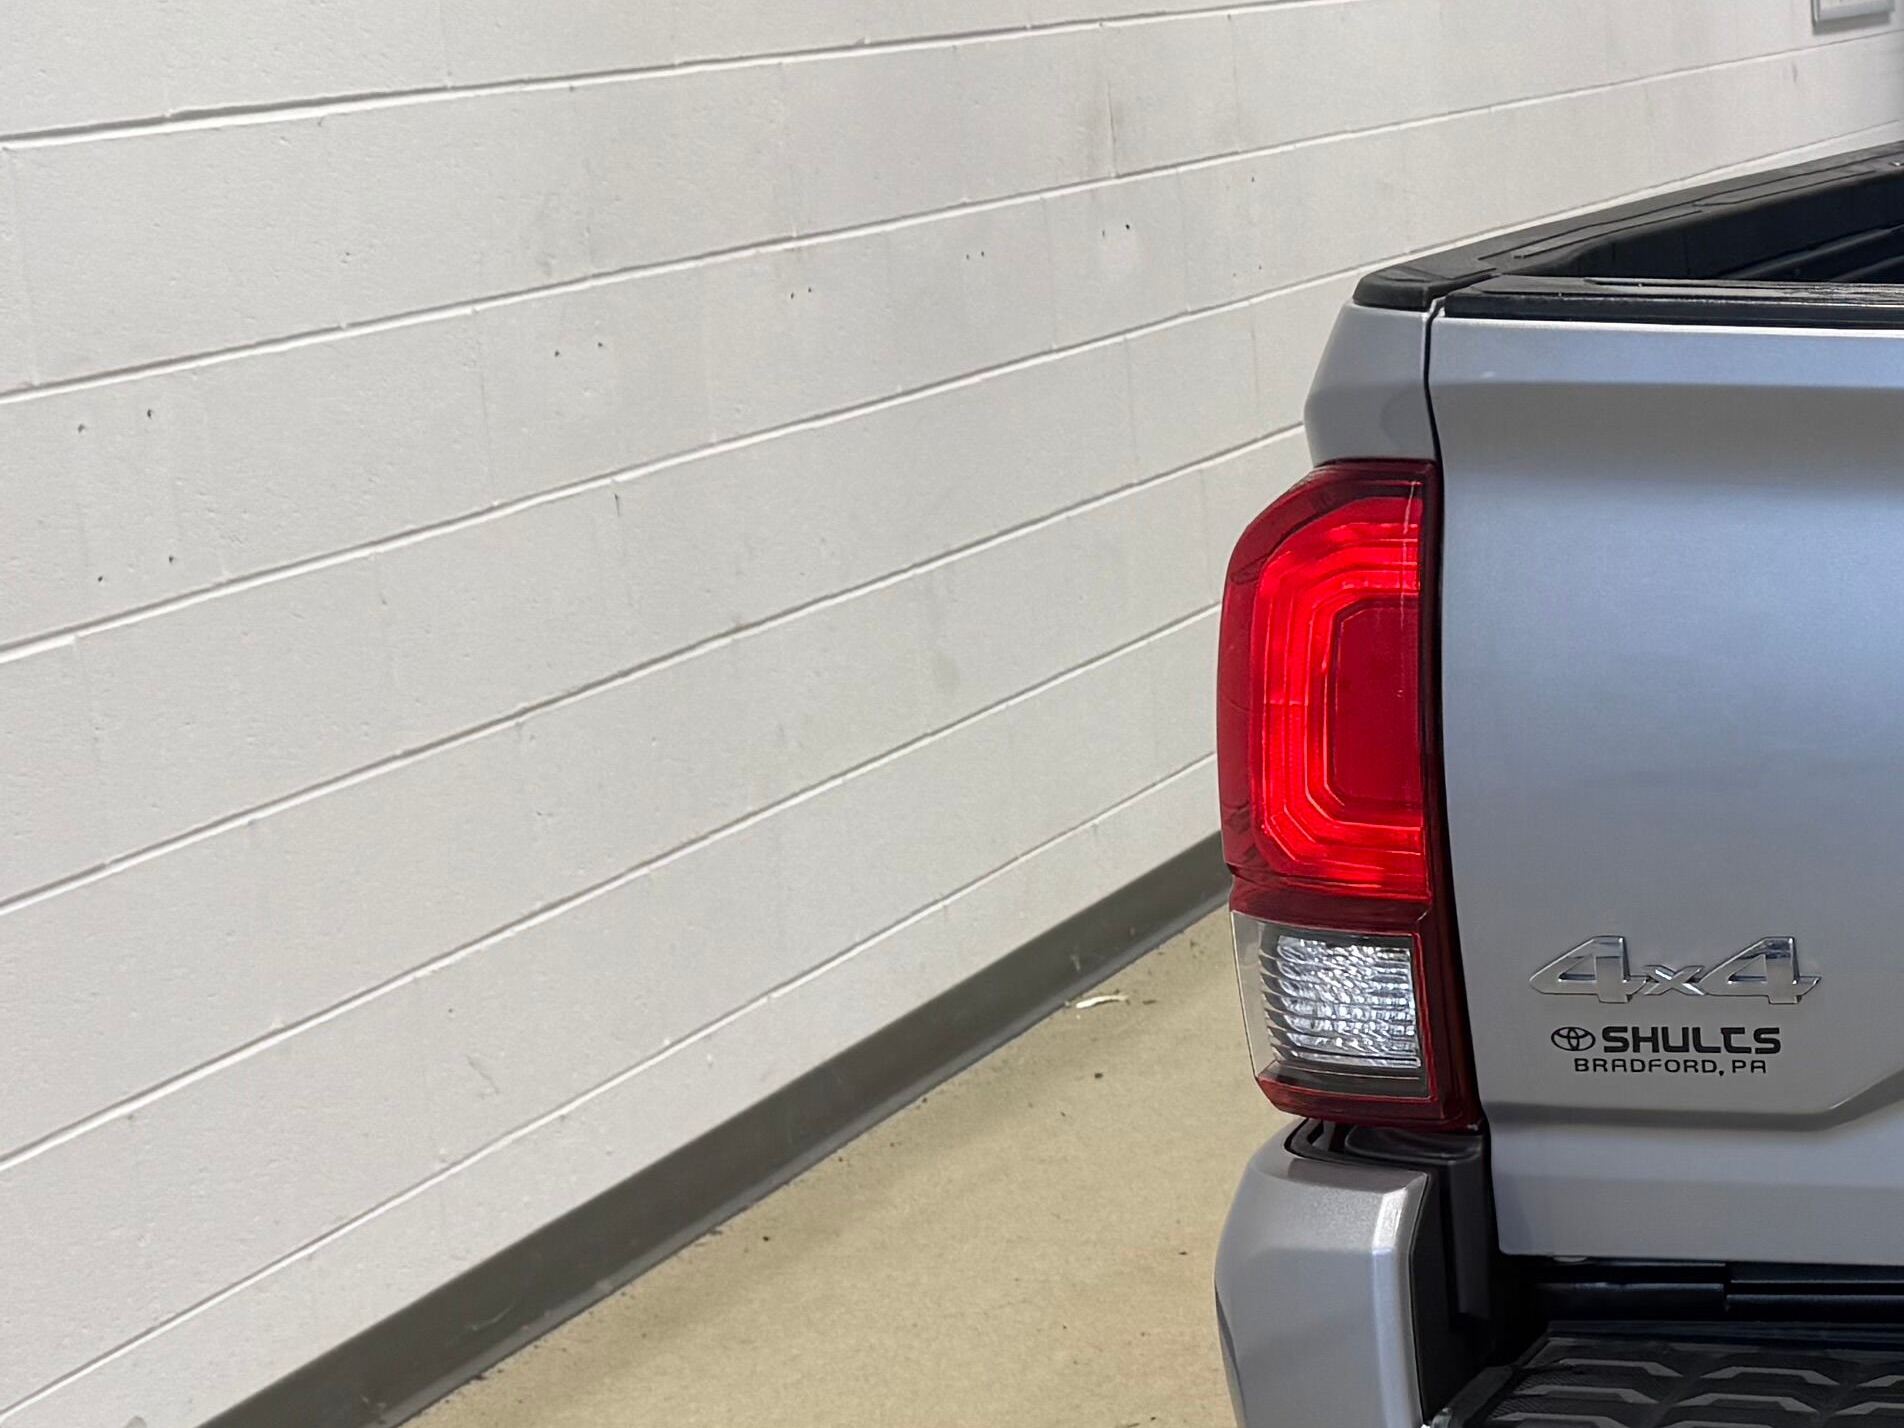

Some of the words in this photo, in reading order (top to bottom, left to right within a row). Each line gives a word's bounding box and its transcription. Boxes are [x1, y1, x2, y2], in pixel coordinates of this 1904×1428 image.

[1528, 935, 1822, 1005] 4x4
[1602, 1026, 1782, 1054] SHULTS
[1574, 1058, 1725, 1077] BRADFORD,
[1732, 1059, 1767, 1074] PA
